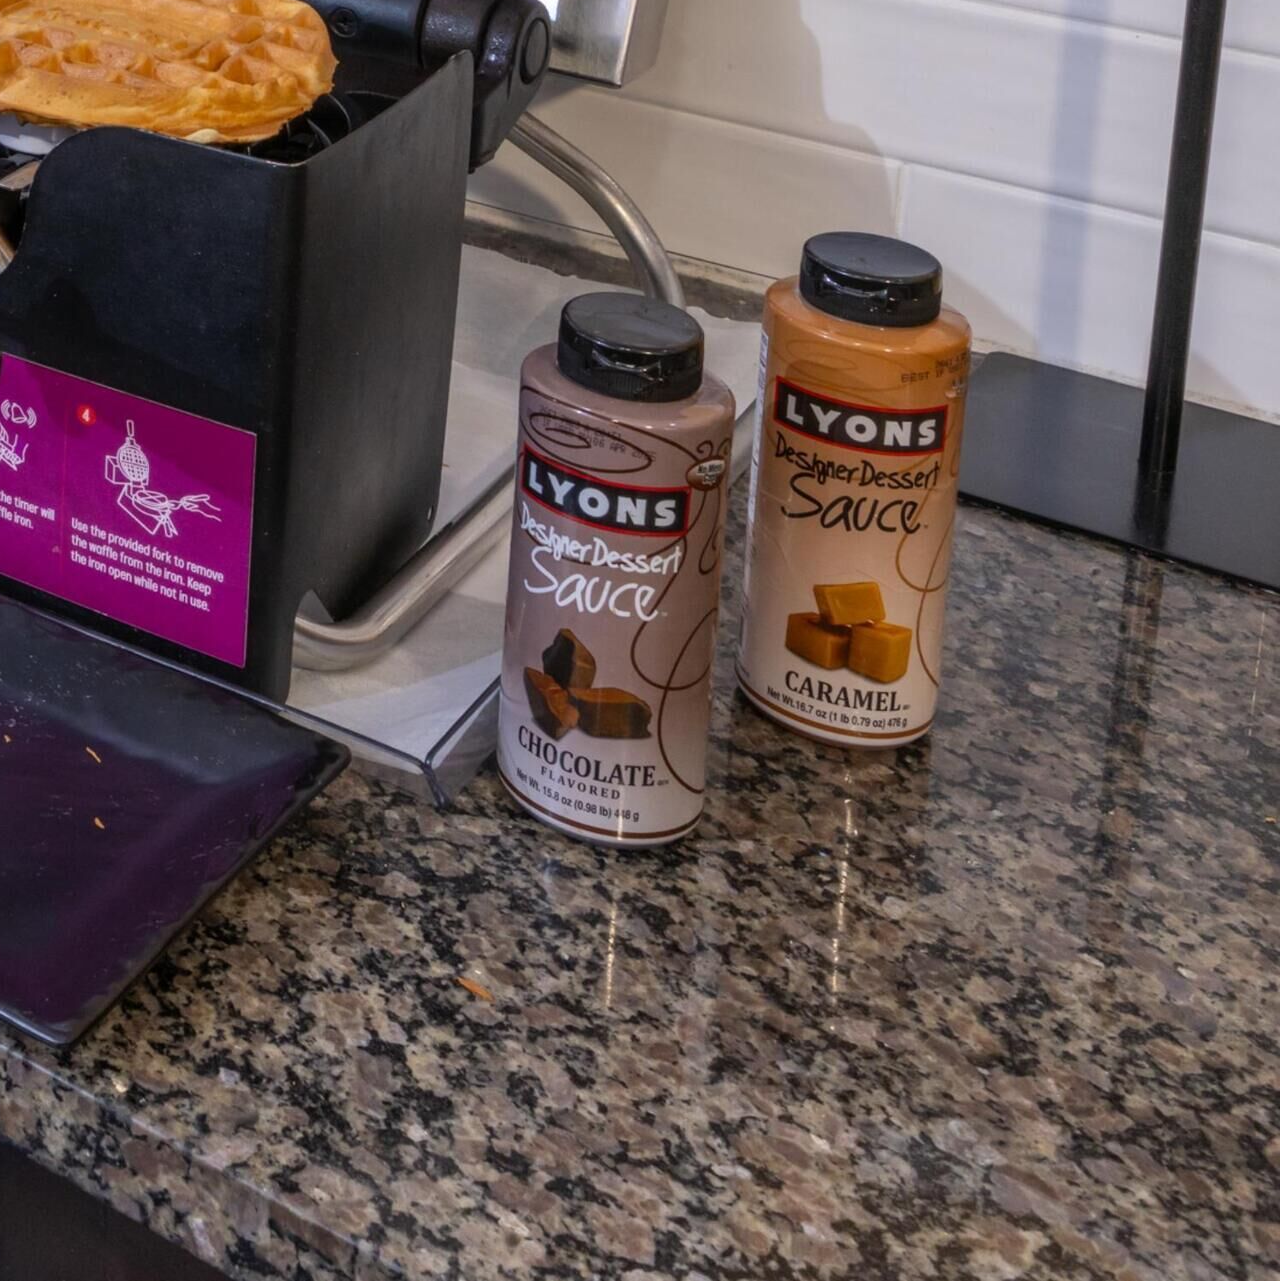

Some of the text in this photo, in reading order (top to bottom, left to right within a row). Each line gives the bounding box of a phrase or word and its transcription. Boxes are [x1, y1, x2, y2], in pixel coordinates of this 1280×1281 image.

[786, 393, 937, 448] LYONS
[13, 511, 35, 530] iron.
[14, 497, 39, 515] timer
[39, 506, 55, 521] will
[528, 461, 677, 527] LYONS
[780, 472, 921, 534] Sauce
[71, 517, 225, 583] Use the provided fork to remove
[71, 534, 212, 597] the waffle from the iron. Keep
[70, 550, 211, 612] the iron open while not in use.
[524, 545, 659, 622] Sauce
[767, 686, 871, 728] Net 16.7 0.79
[784, 670, 901, 712] CARAMEL
[517, 724, 656, 788] CHOCOLATE
[540, 765, 621, 801] FLAVORED
[543, 786, 598, 815] 15.8 (0.98
